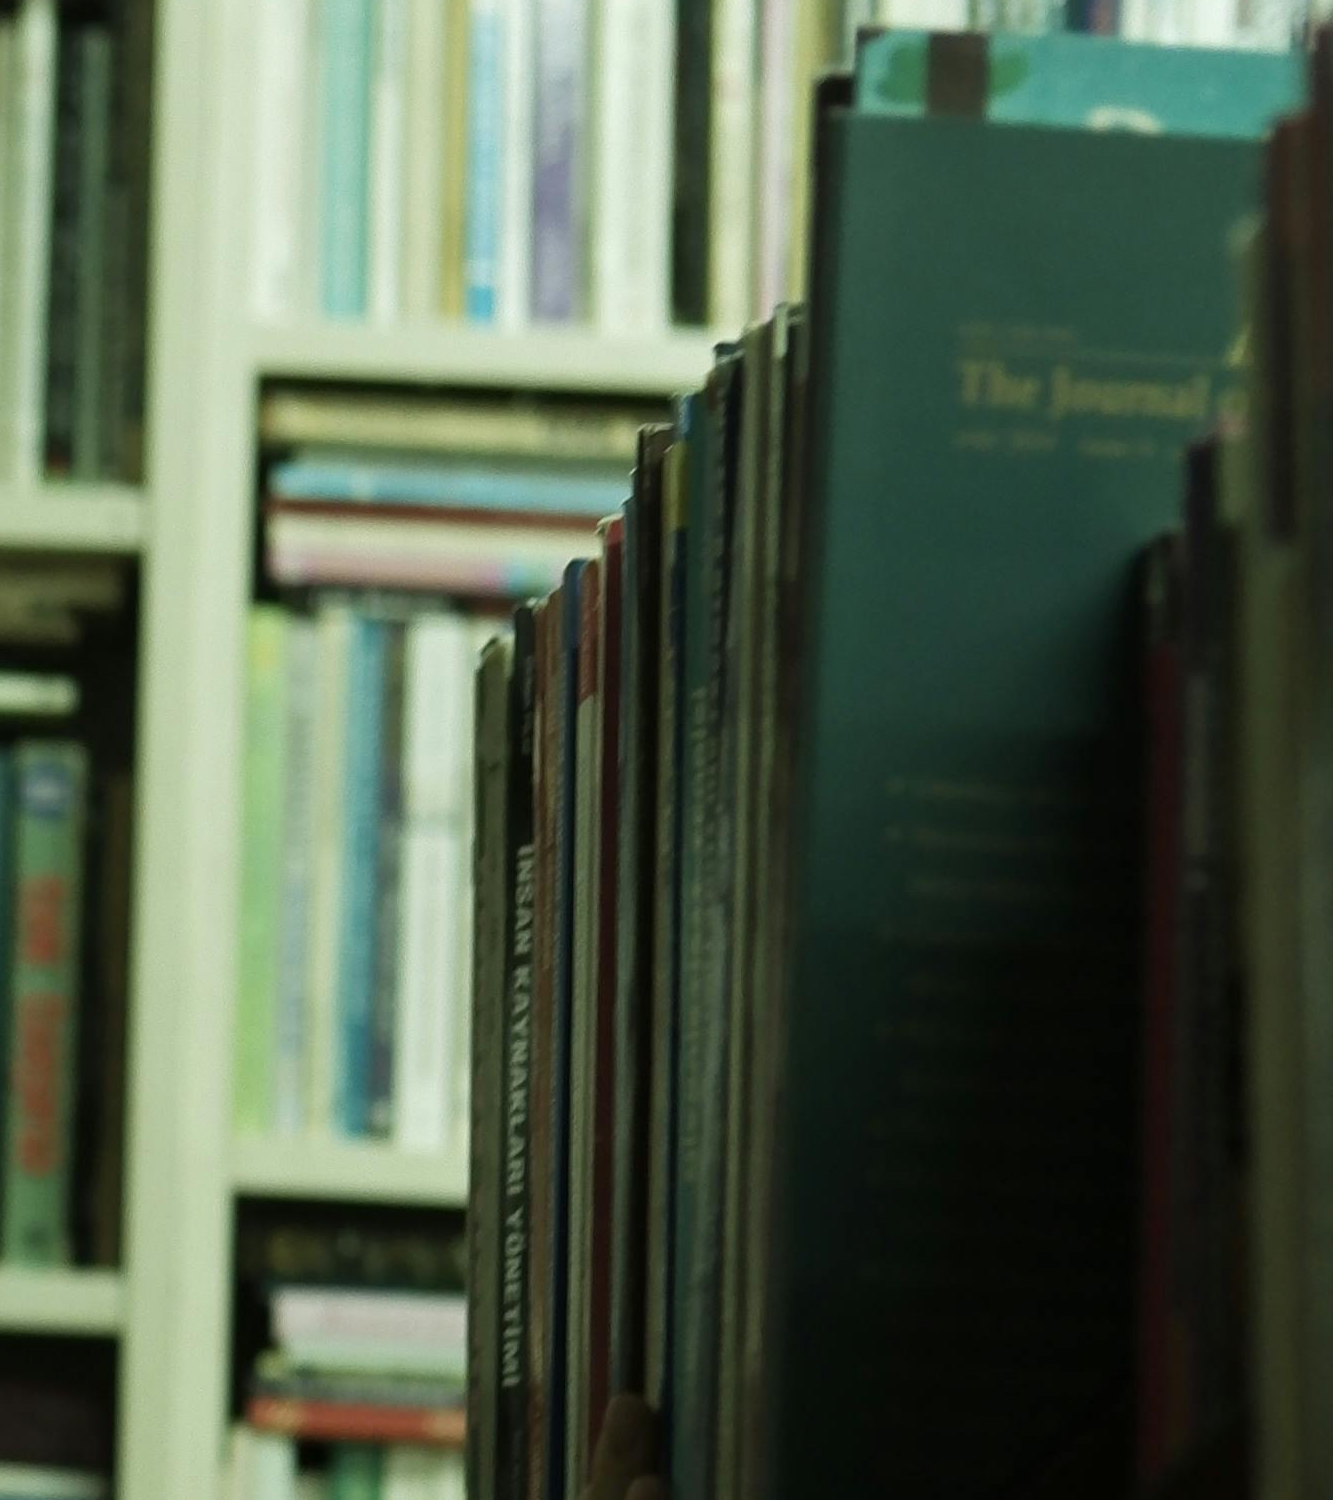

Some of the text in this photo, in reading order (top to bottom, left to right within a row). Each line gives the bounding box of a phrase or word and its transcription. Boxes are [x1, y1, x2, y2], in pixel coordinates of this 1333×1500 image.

[958, 358, 1039, 409] The
[1047, 363, 1210, 420] Journal
[500, 842, 535, 1389] İNSAN KAYNAKLARI YÖNETİMİ
